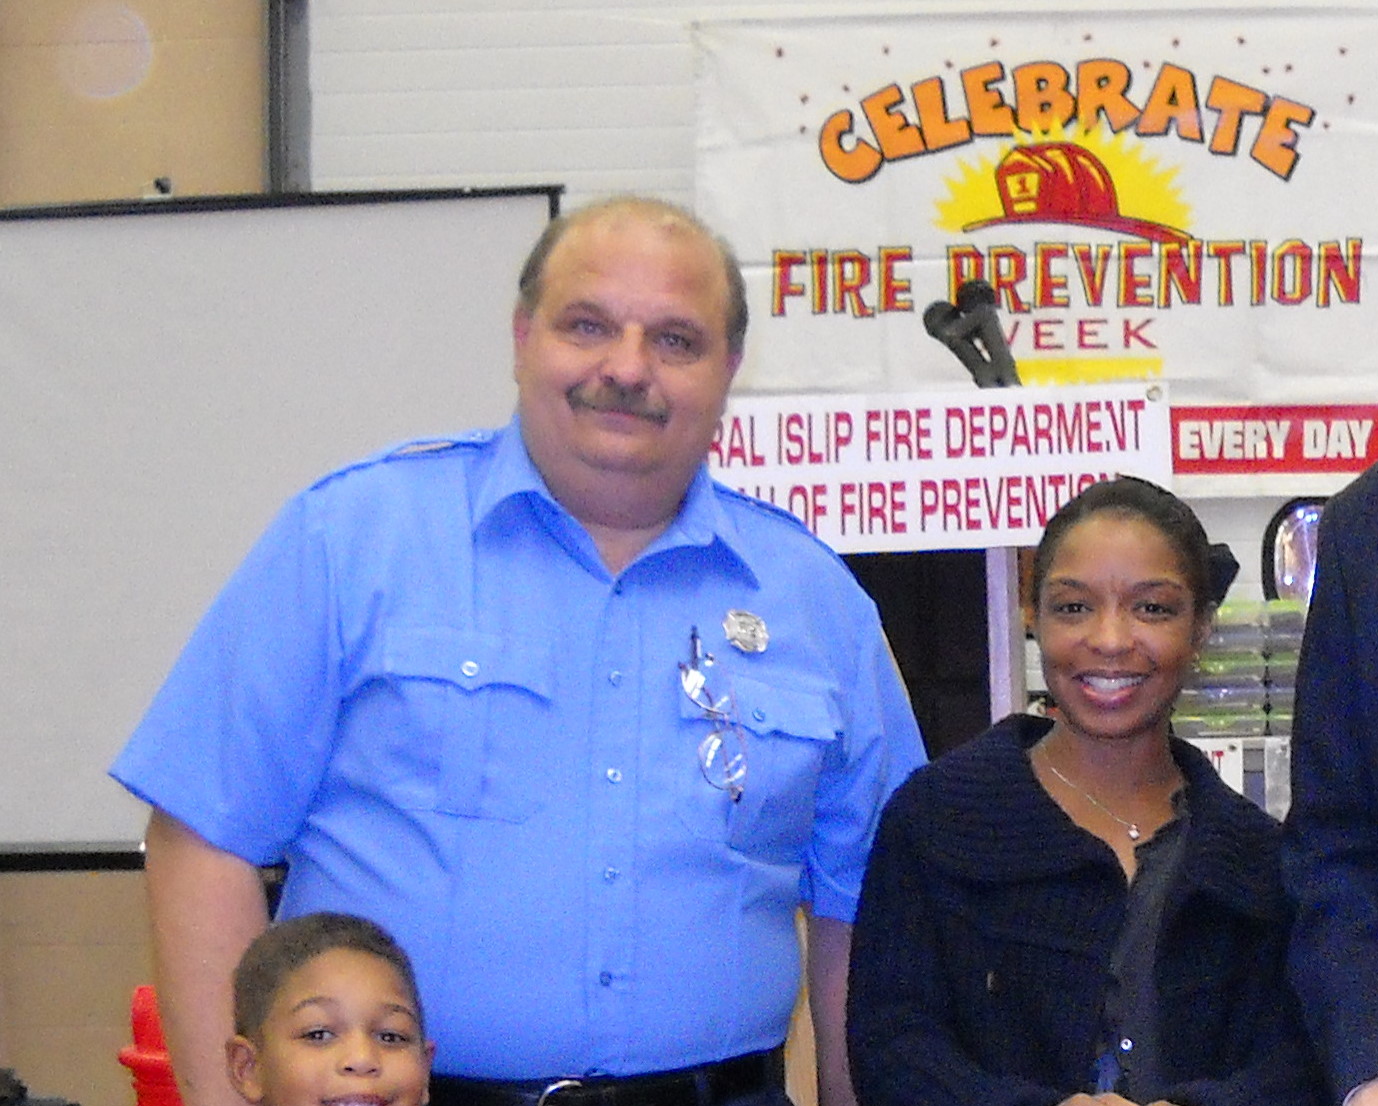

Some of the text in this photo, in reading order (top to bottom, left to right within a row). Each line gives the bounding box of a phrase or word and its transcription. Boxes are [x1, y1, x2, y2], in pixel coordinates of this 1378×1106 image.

[818, 58, 1317, 184] CELEBRATE
[771, 236, 1363, 318] FIRE PREVENTION
[777, 411, 853, 466] ISLIP
[865, 407, 933, 462] FIRE
[945, 399, 1146, 459] DEPARMENT
[1179, 419, 1374, 461] EVERY DAY
[788, 483, 828, 536] OF
[840, 480, 908, 536] FIRE
[920, 470, 1110, 532] PREVENT
